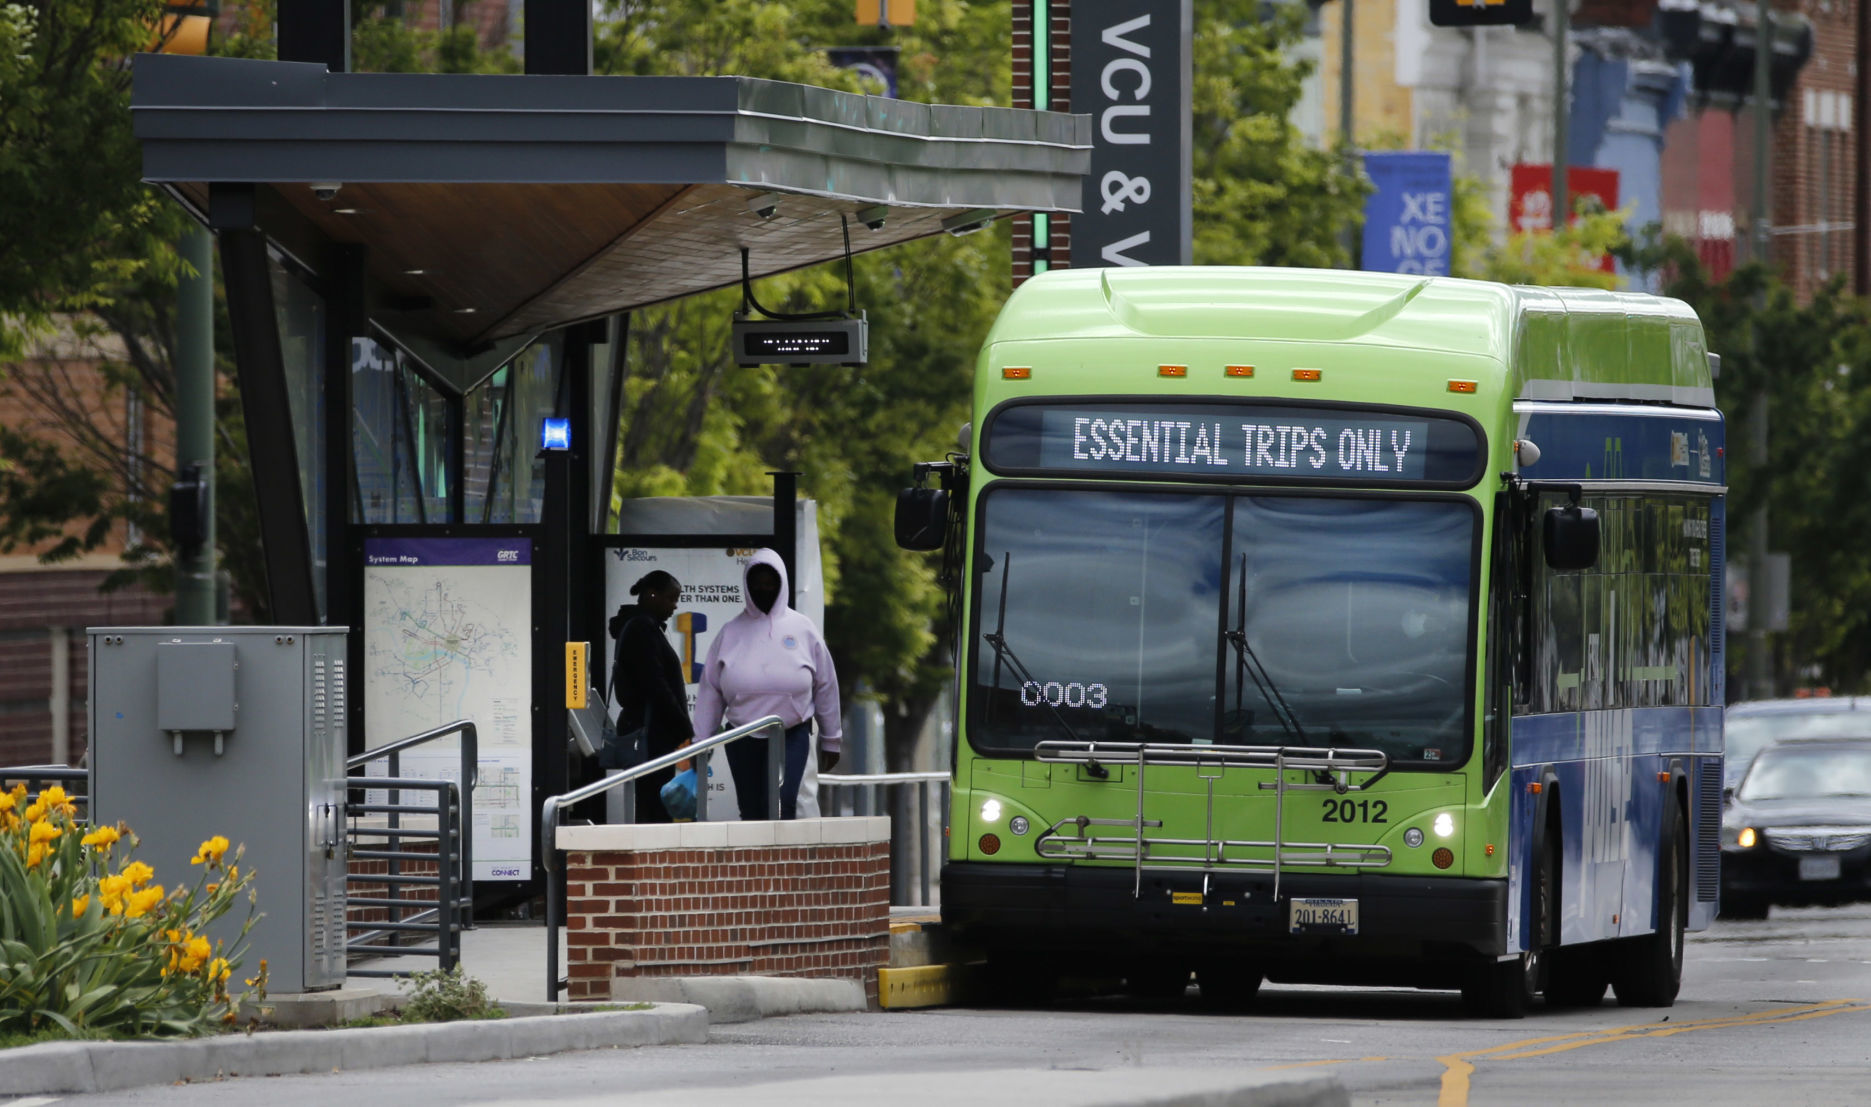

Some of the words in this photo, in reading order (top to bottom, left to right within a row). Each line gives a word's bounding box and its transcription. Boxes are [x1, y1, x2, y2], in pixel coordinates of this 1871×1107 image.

[1101, 14, 1151, 144] VCU
[1101, 170, 1151, 215] &
[1401, 192, 1445, 224] XE
[1391, 225, 1447, 258] NO
[1073, 417, 1228, 466] ESSENTIAL
[1241, 424, 1327, 469] TRIPS
[1338, 428, 1411, 472] ONLY
[369, 555, 398, 564] System
[399, 555, 418, 564] Map
[497, 550, 519, 559] GRTC
[695, 594, 720, 603] THAN
[722, 594, 743, 603] ONE.
[698, 584, 740, 594] SYSTEMS
[1021, 681, 1108, 709] 0003
[1322, 799, 1388, 823] 2012
[491, 869, 520, 877] CONNECT
